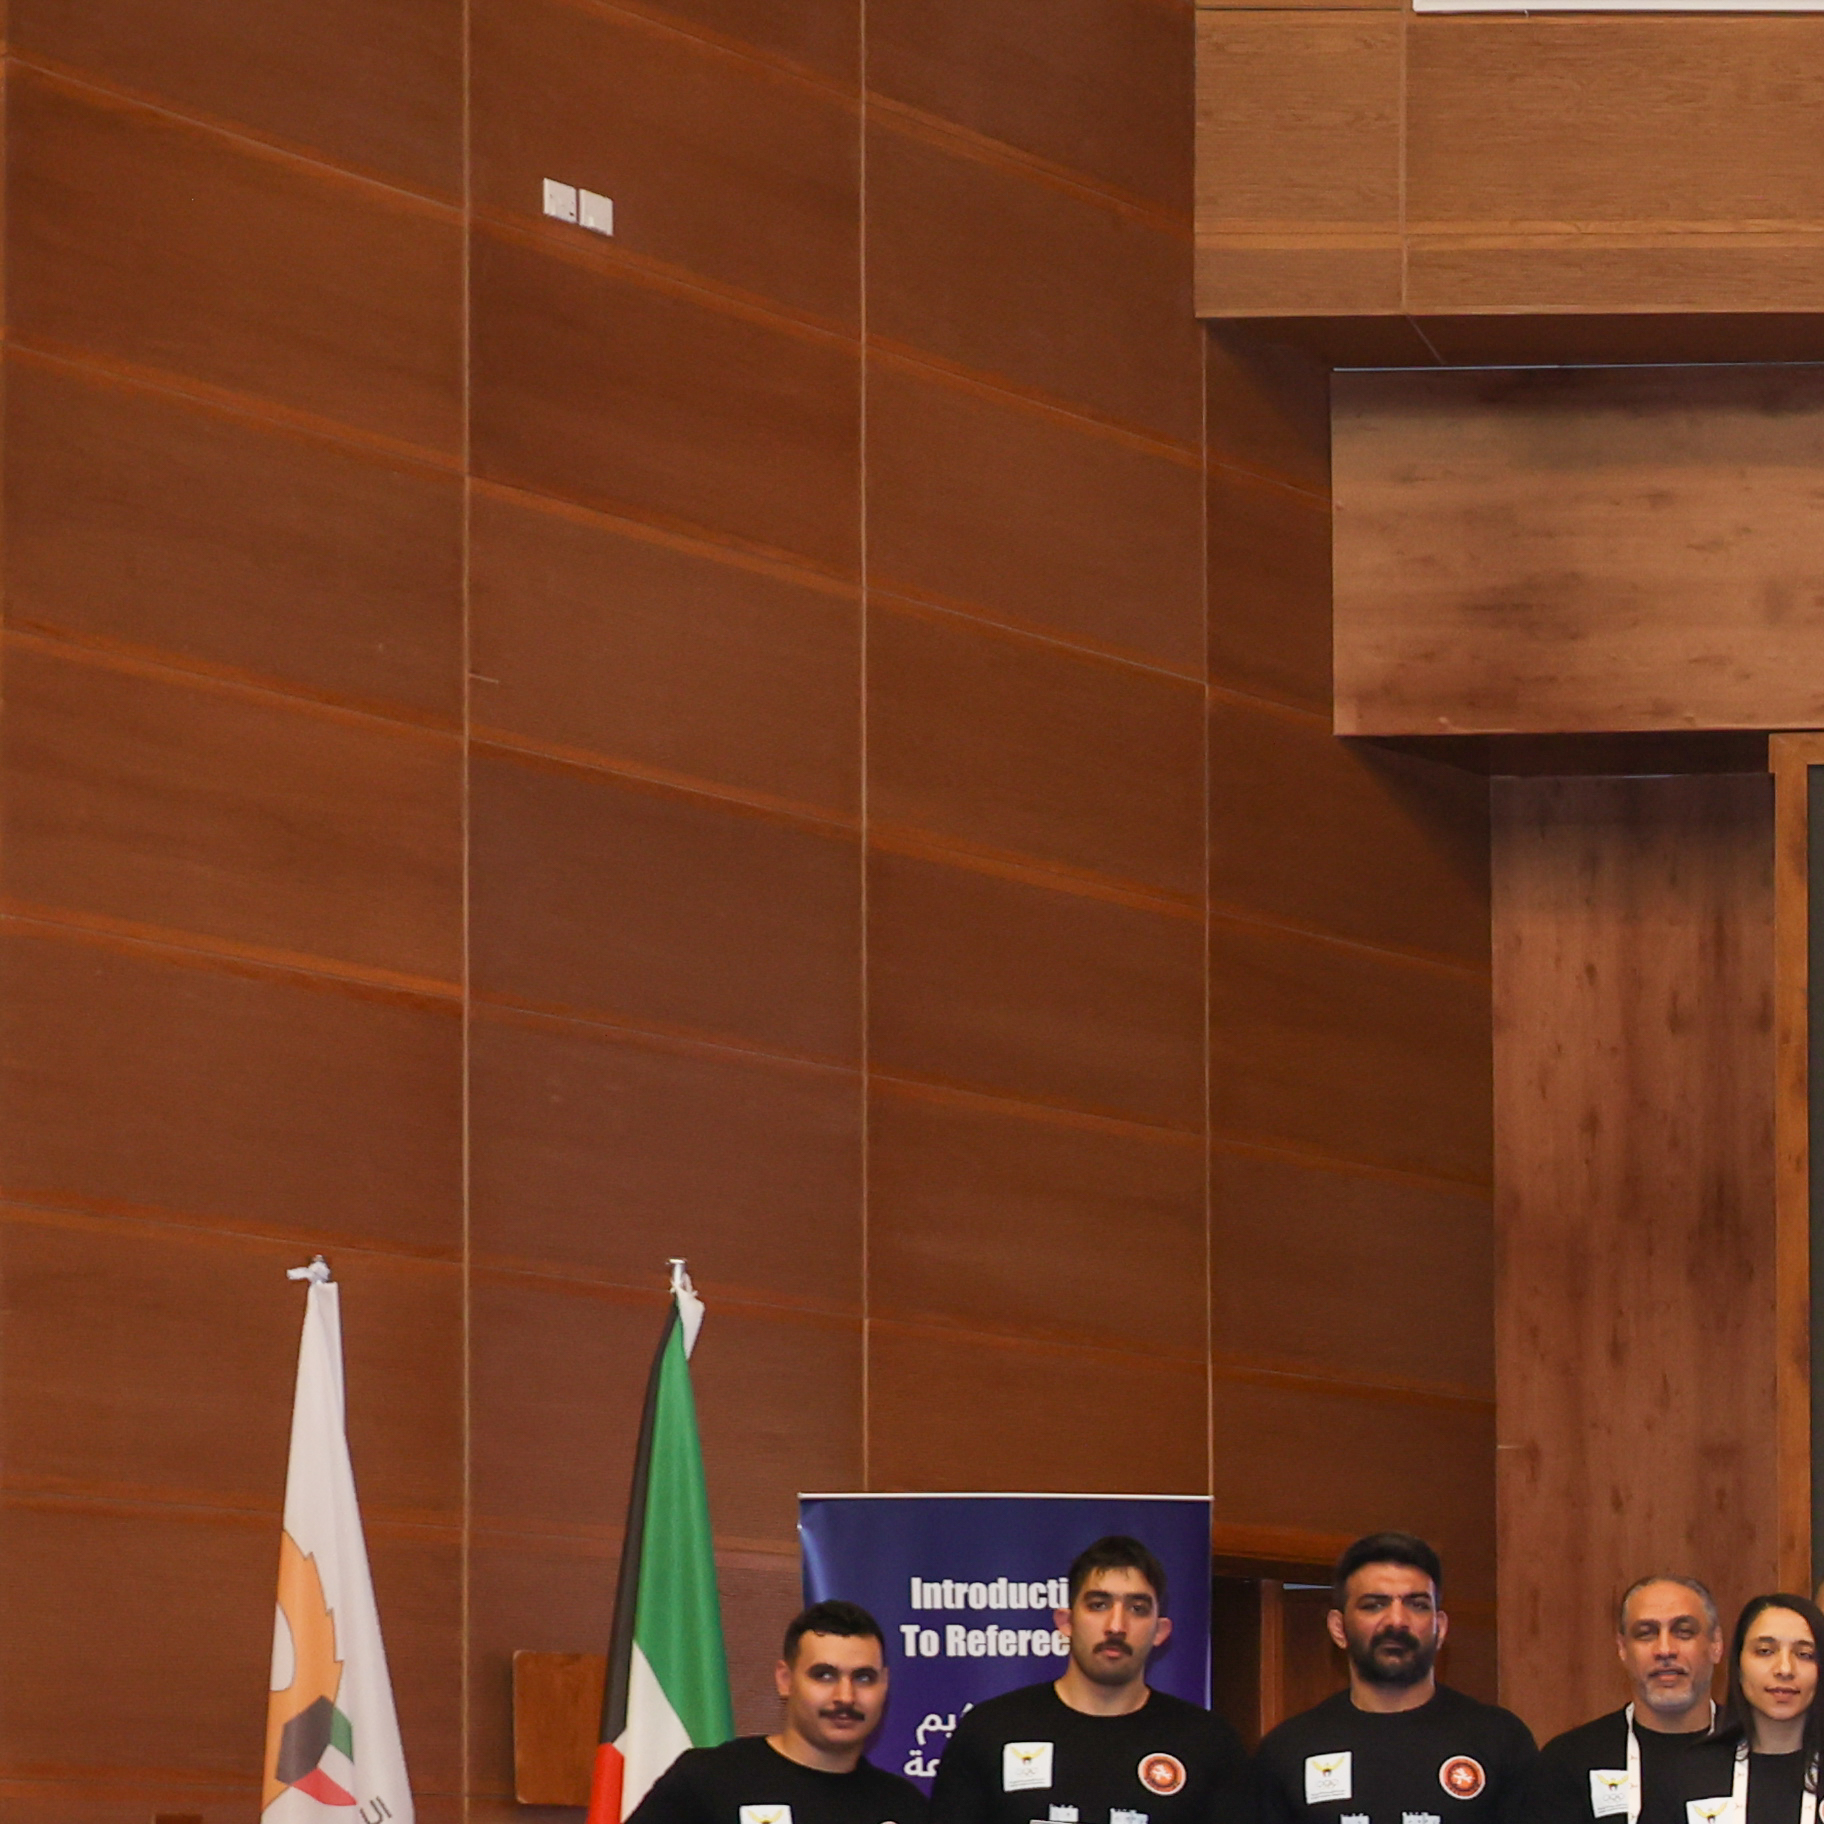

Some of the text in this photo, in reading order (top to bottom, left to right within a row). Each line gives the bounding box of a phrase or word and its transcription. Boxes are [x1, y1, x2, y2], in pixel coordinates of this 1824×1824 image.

[910, 1576, 1070, 1610] Introducti
[900, 1624, 1071, 1657] To Referee
